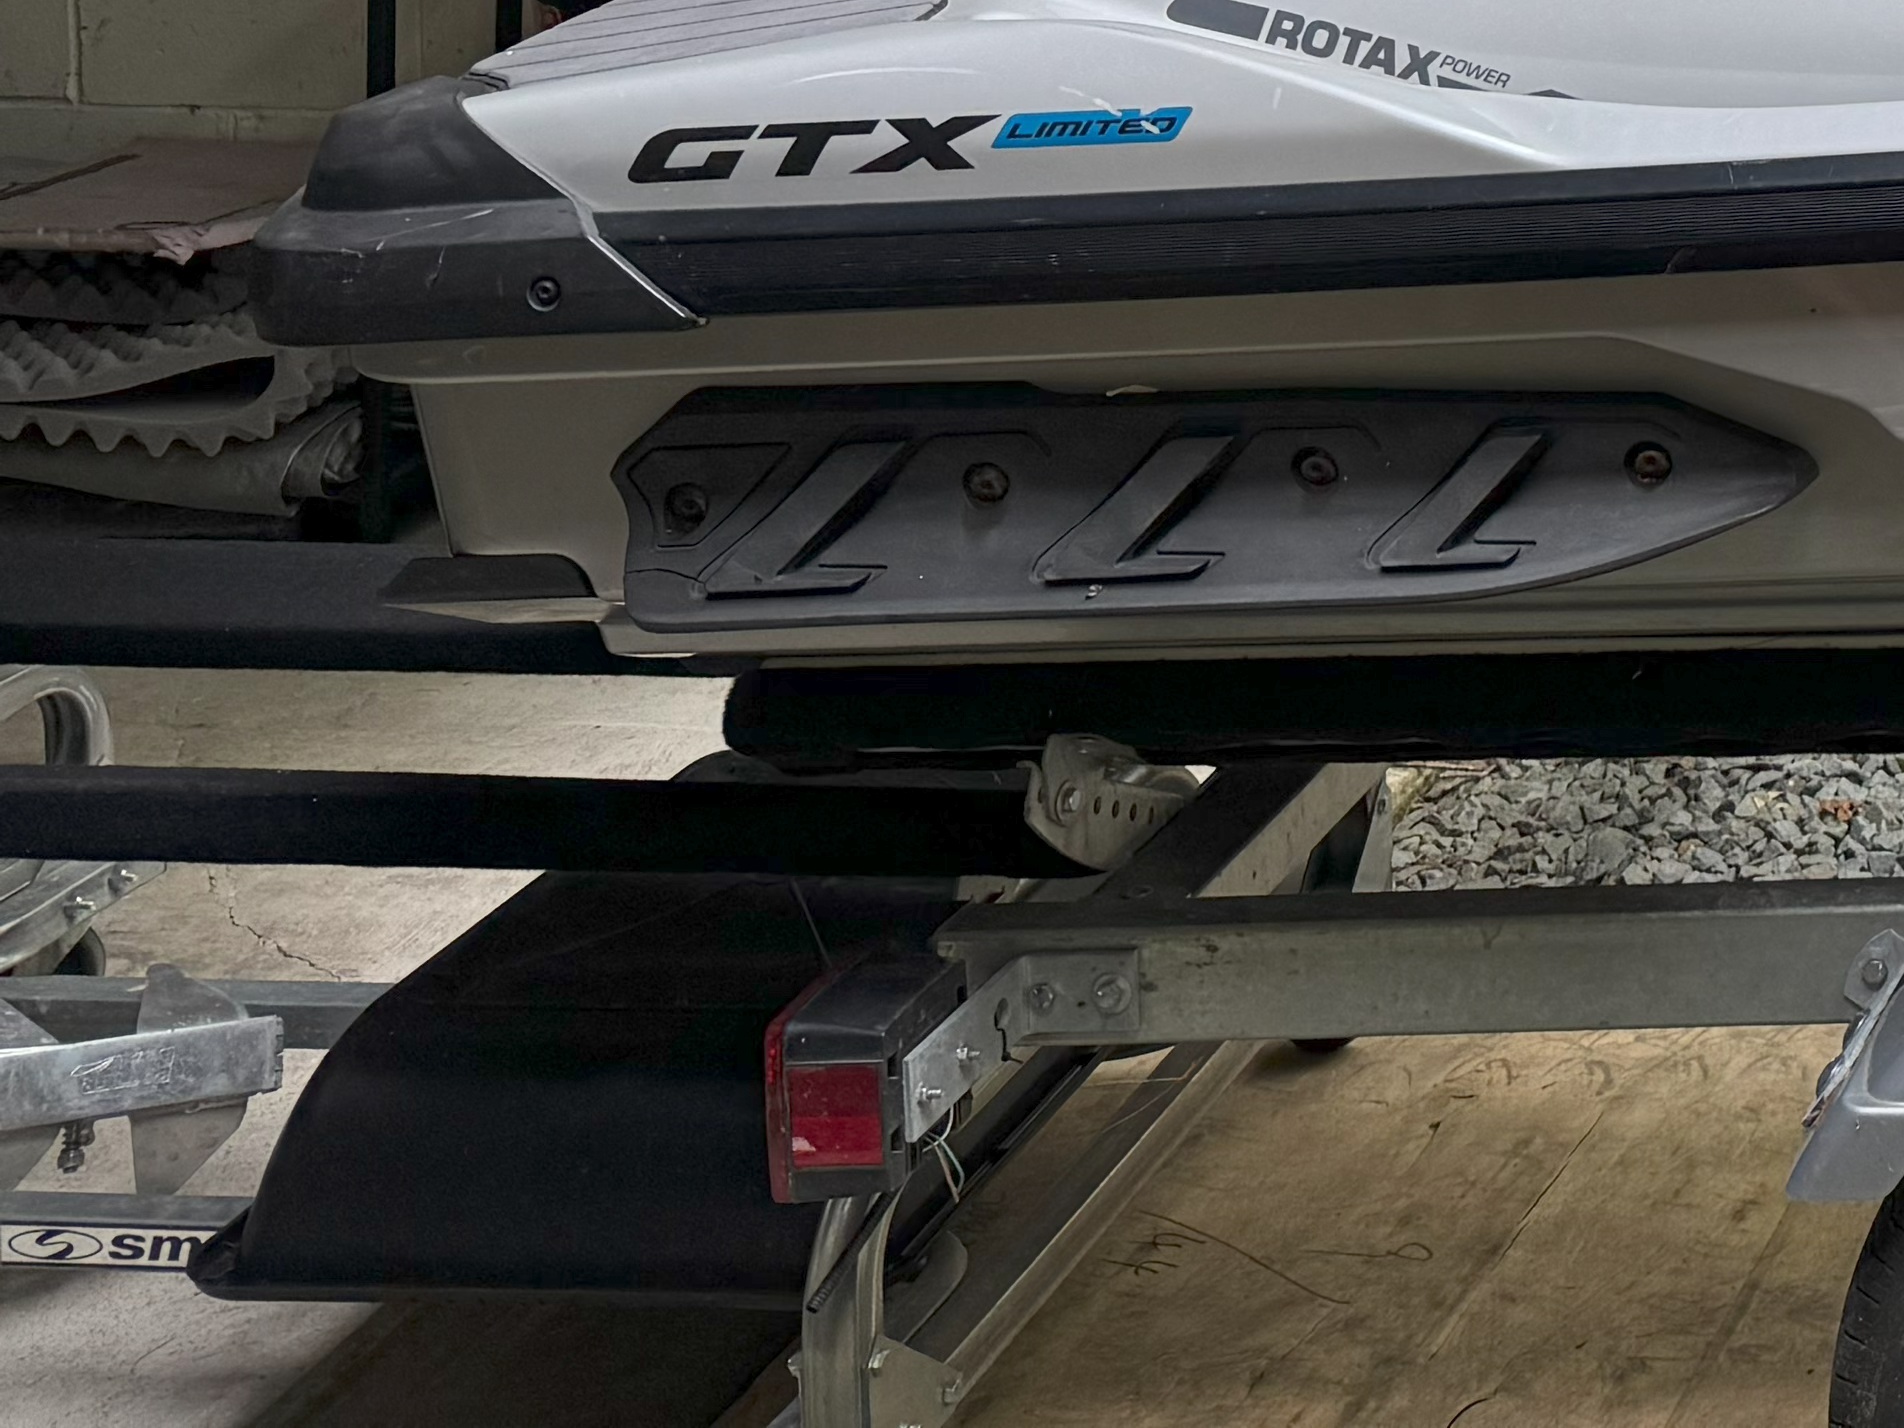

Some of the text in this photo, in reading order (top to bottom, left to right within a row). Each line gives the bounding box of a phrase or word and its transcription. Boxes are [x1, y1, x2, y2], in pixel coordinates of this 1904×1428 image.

[1265, 8, 1512, 89] ROTAX POWER
[627, 113, 1178, 184] GTX LIMITED
